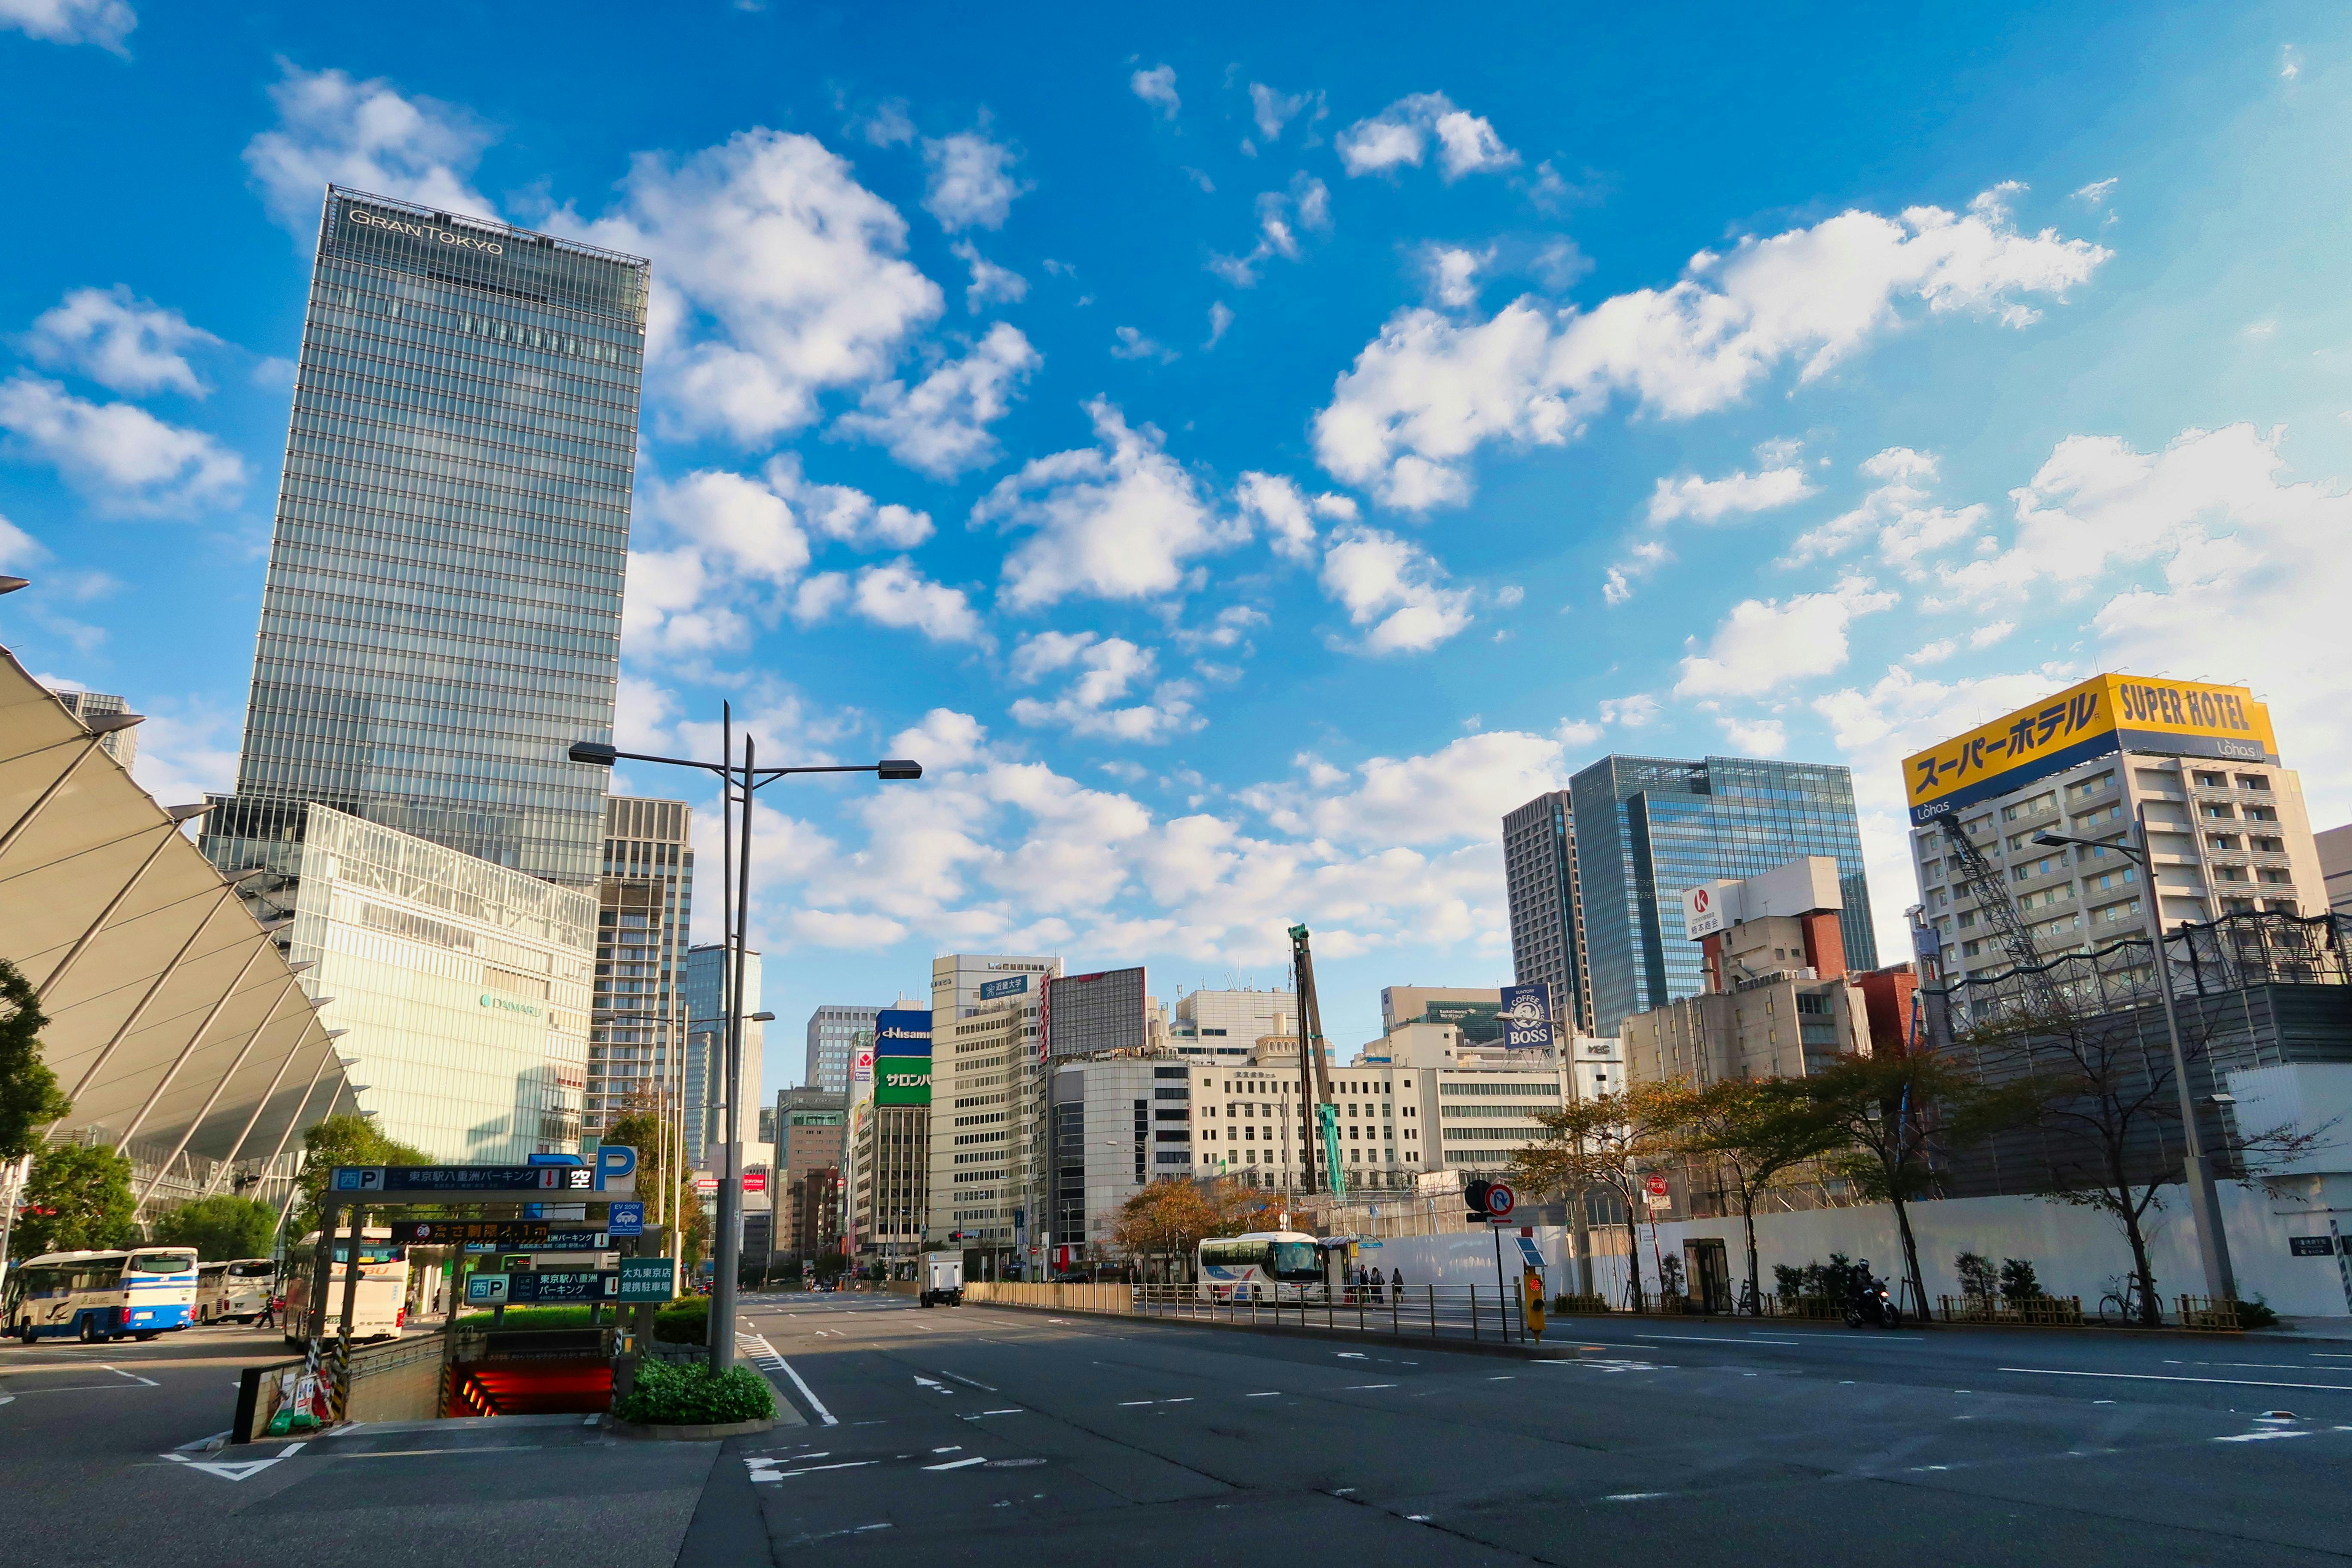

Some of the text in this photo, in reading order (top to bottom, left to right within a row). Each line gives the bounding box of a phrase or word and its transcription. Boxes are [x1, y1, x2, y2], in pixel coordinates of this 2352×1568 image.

[2120, 683, 2249, 730] SUPER HOTEL
[1915, 692, 2098, 795] スーパーホテル
[996, 978, 1022, 991] 近畿大学
[493, 998, 542, 1017] DAIMARU
[1511, 995, 1540, 1006] COFFEE
[882, 1026, 932, 1039] Hisami
[1510, 1029, 1548, 1044] BOSS
[594, 1146, 636, 1191] P
[341, 1169, 591, 1188] 西 P 東京駅八重洲パーキング 空
[622, 1267, 671, 1279] 大丸東京店
[473, 1281, 487, 1295] 西
[490, 1281, 502, 1295] P
[539, 1273, 598, 1284] 東京駅八重洲
[538, 1284, 585, 1295] パーキング
[622, 1281, 671, 1293] 提携駐車場
